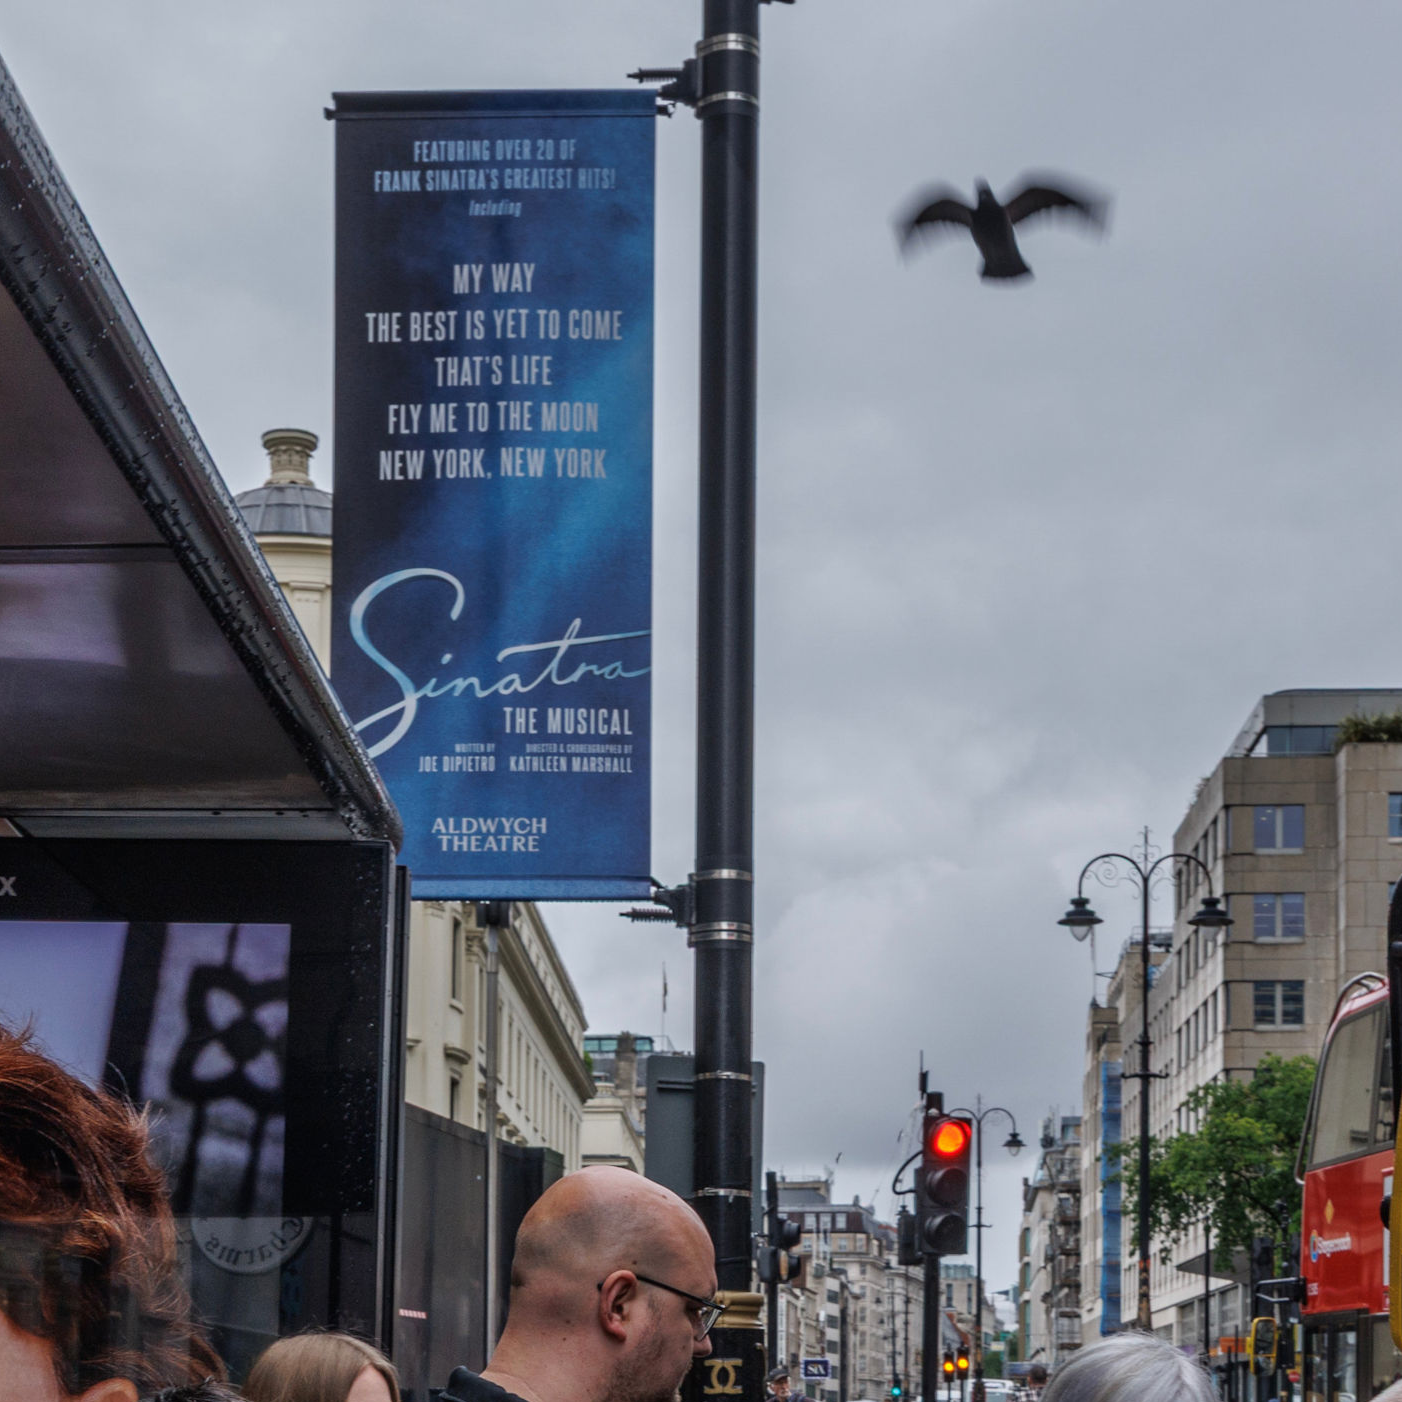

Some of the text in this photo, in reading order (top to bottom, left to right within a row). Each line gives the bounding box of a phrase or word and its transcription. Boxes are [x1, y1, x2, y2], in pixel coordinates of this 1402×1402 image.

[413, 138, 577, 163] FEATURING OVER 20 OF
[373, 167, 616, 193] FRANK SINATRA'S GREATEST HITS!
[452, 262, 535, 294] MY WAY
[365, 308, 623, 343] THE BEST IS YET TO COME
[434, 355, 553, 387] THAT'S LIFE
[387, 401, 599, 435] FLY ME TO THE MOON
[379, 447, 607, 481] NEW YORK, NEW YORK
[349, 567, 652, 759] Sinatra
[502, 706, 634, 736] THE MUSICAL
[418, 755, 496, 773] JOE DIPIETRO
[509, 755, 634, 774] KATHLEEN MARSHALL
[431, 817, 548, 835] ALDWYCH
[437, 835, 541, 853] THEATRE
